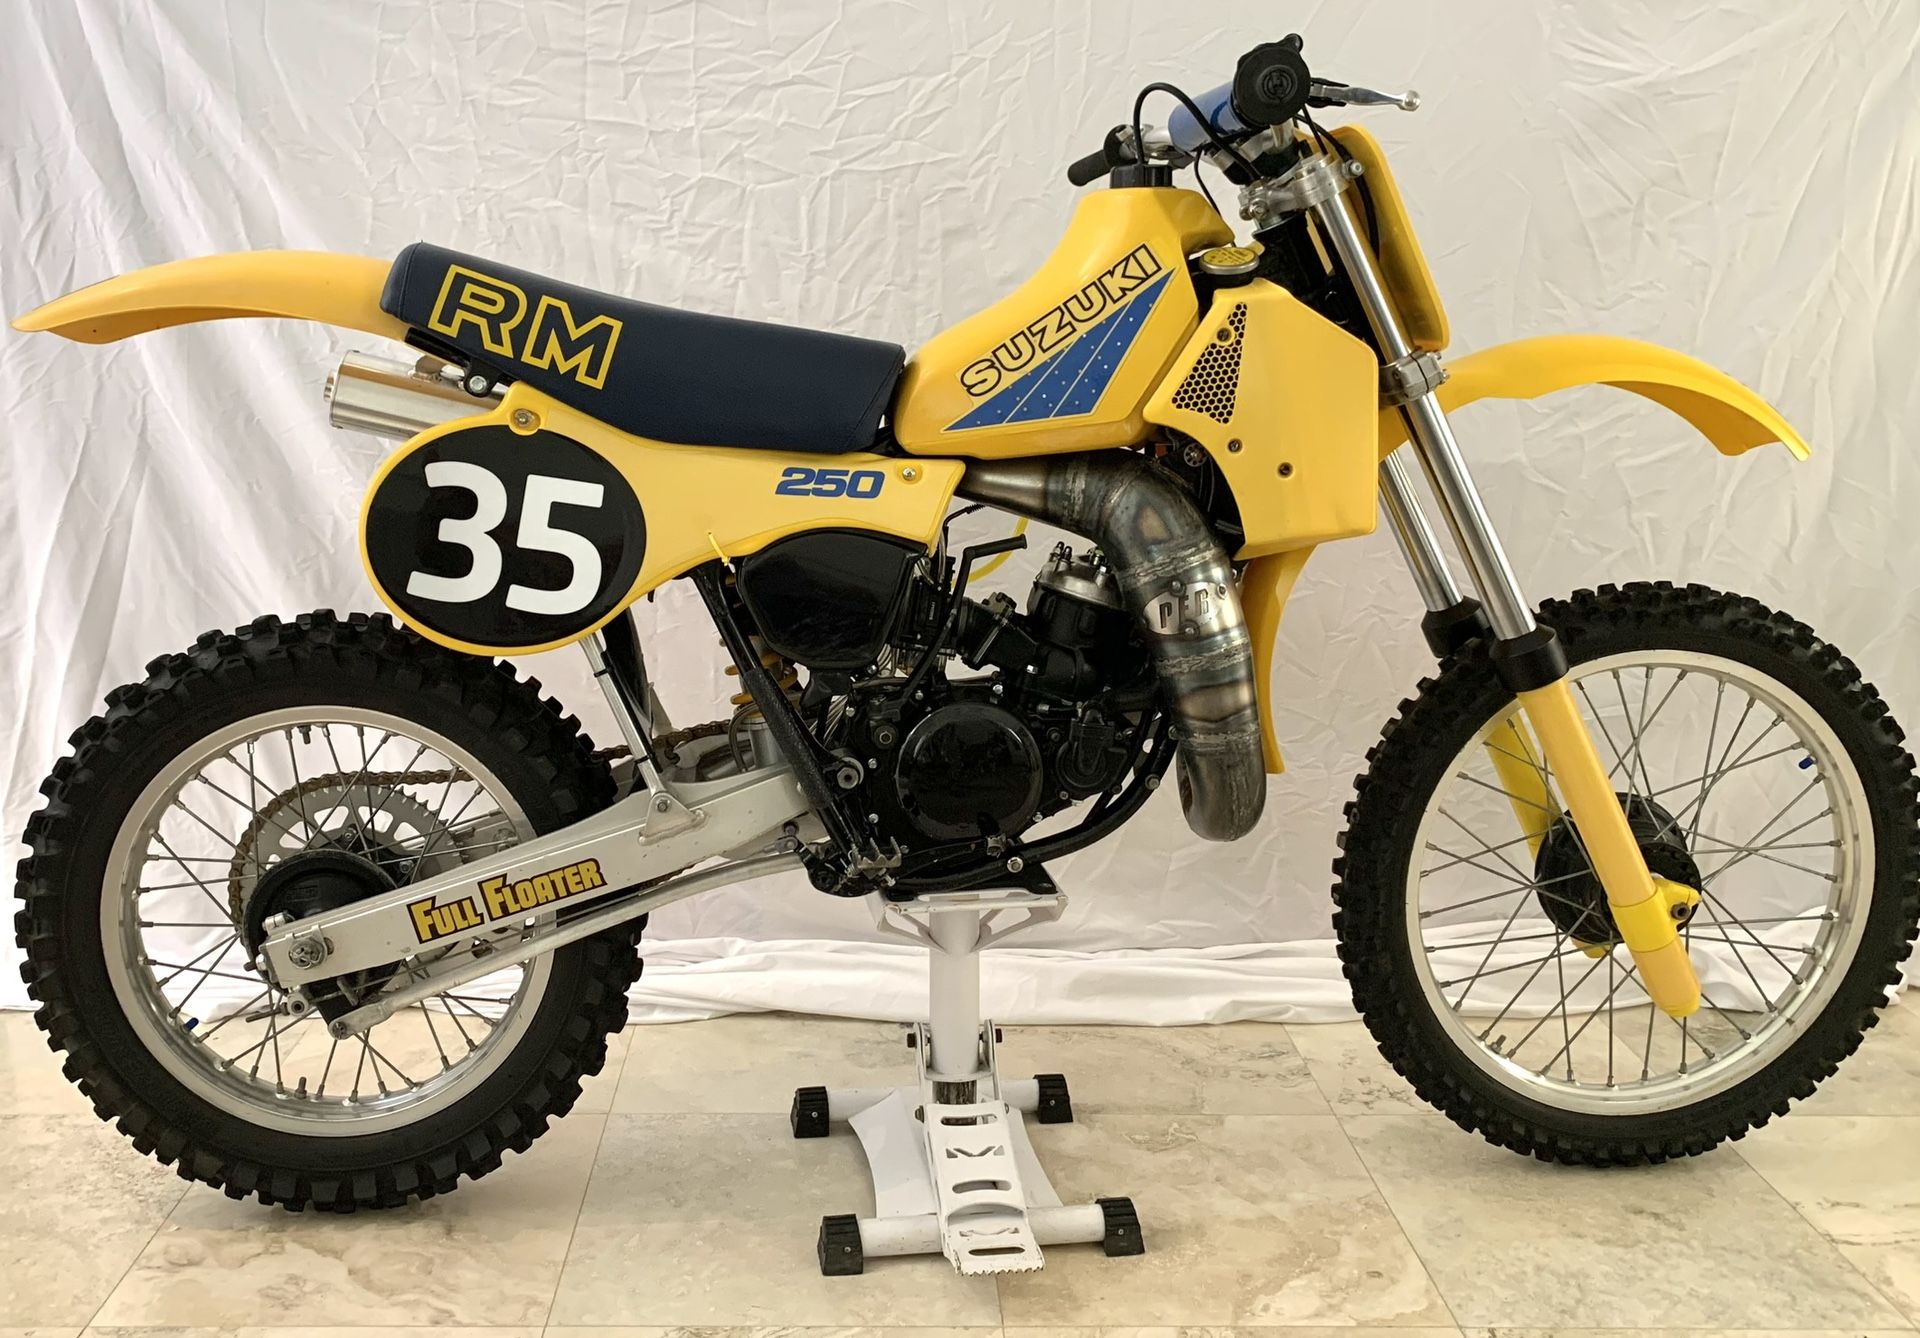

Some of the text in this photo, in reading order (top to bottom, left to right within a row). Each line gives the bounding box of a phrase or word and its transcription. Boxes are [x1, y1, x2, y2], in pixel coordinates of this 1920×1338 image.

[428, 264, 623, 390] RM
[960, 243, 1163, 397] SUZUKI
[406, 461, 605, 615] 35
[775, 467, 885, 498] 250
[407, 858, 606, 943] FULL FLOATER
